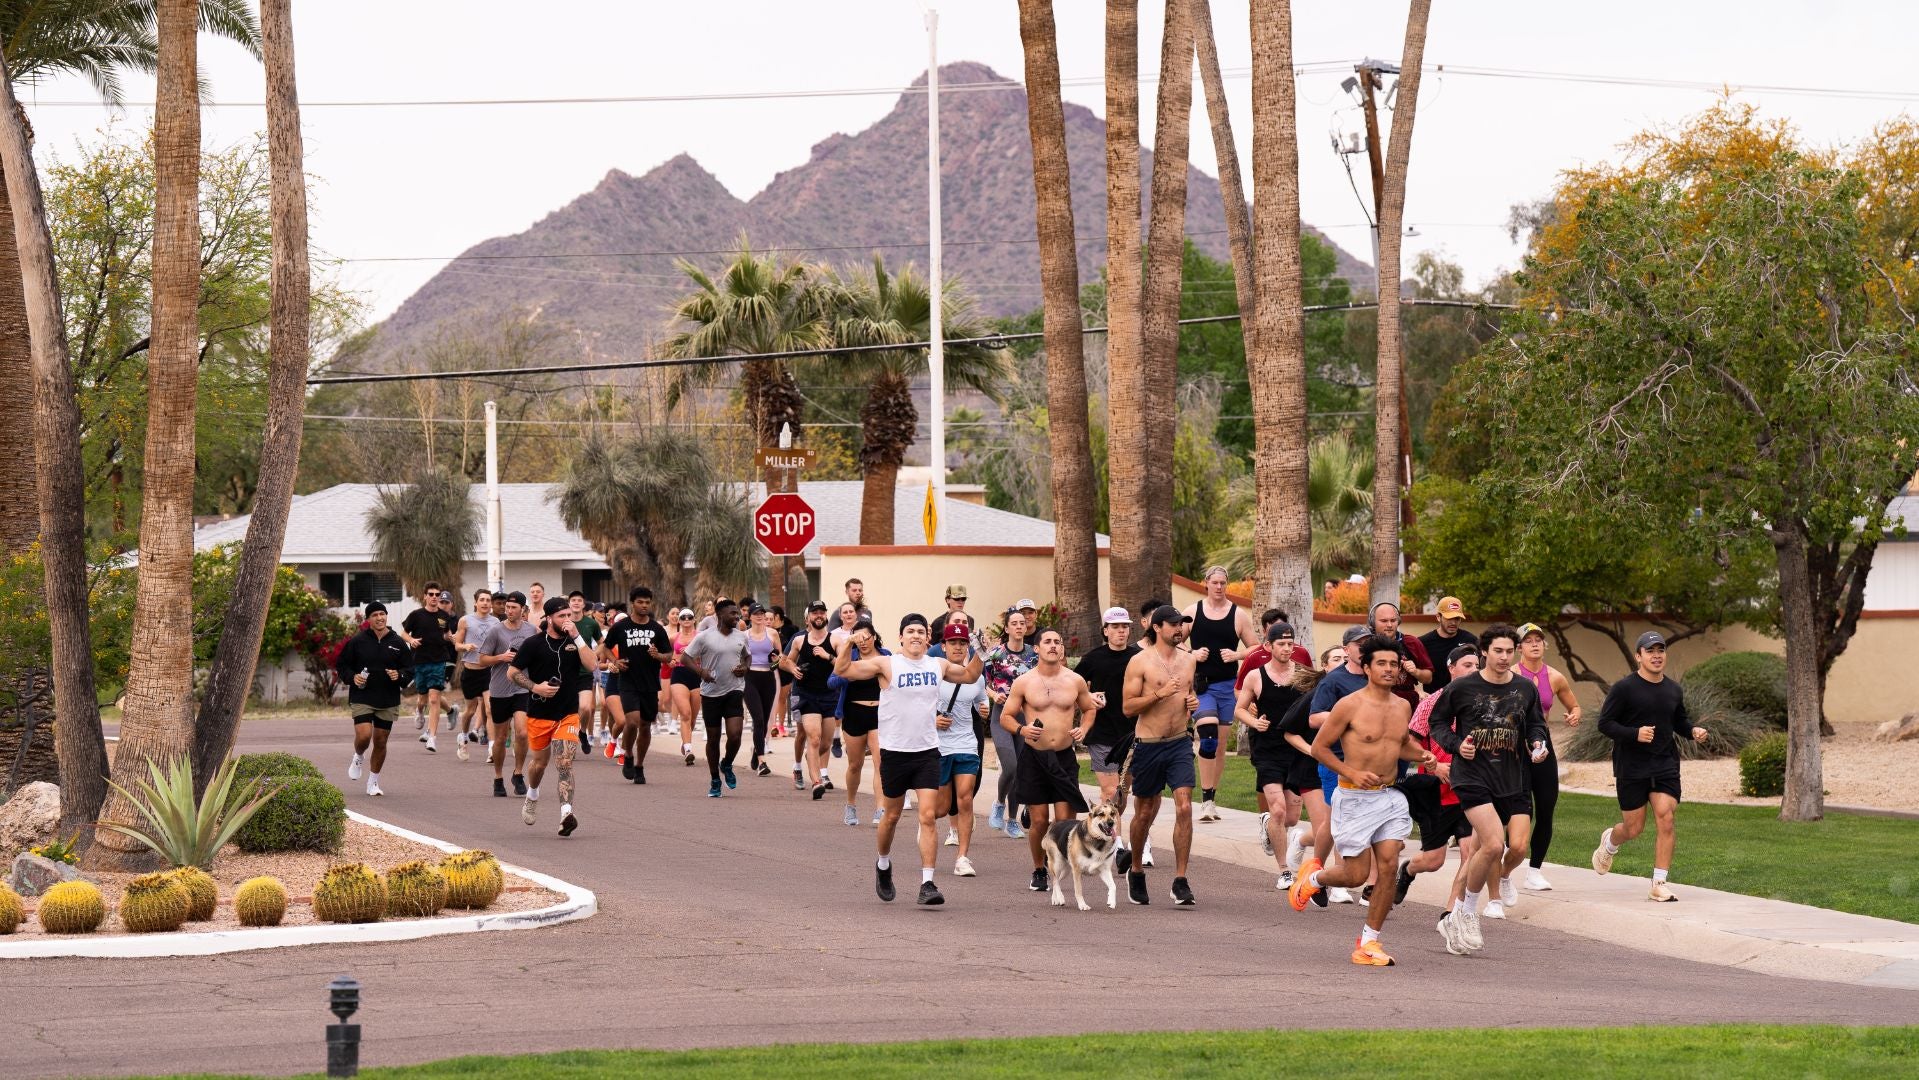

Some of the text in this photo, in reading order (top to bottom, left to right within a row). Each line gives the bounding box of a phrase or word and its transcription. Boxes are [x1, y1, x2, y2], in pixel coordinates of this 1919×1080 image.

[765, 456, 805, 467] MILLER
[759, 513, 812, 536] STOP
[626, 637, 651, 647] DIPER
[898, 671, 938, 688] CRSVR
